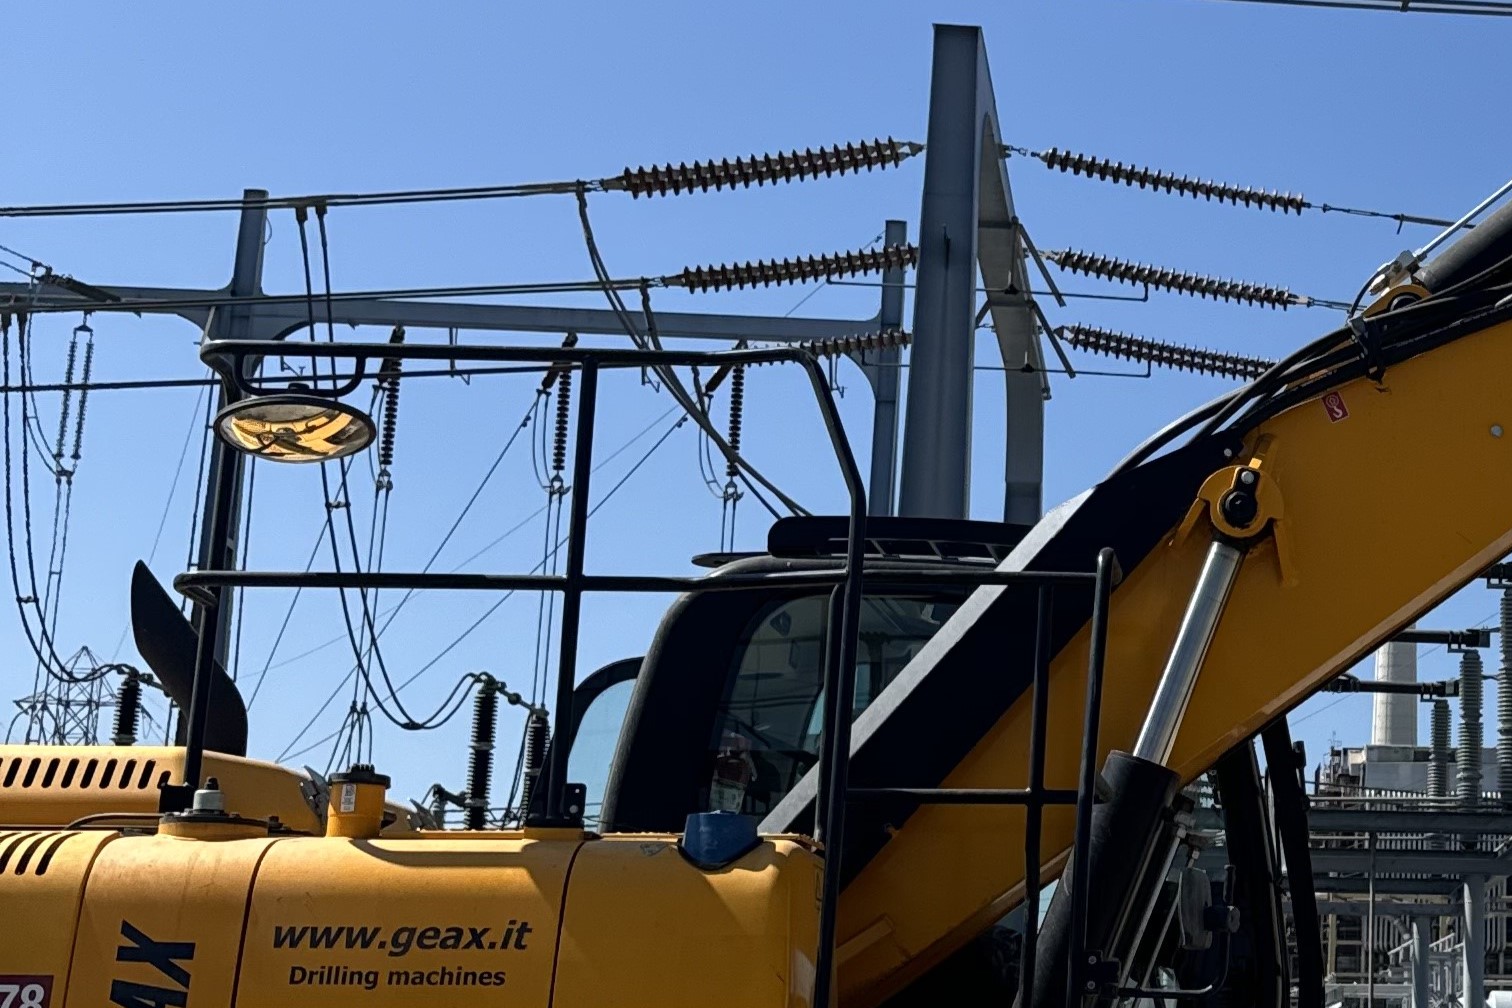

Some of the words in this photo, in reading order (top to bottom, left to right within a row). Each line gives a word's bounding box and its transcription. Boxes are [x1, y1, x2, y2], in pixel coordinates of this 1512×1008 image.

[272, 920, 532, 956] www.geax.it
[288, 965, 379, 990] Drilling
[387, 965, 507, 987] machines
